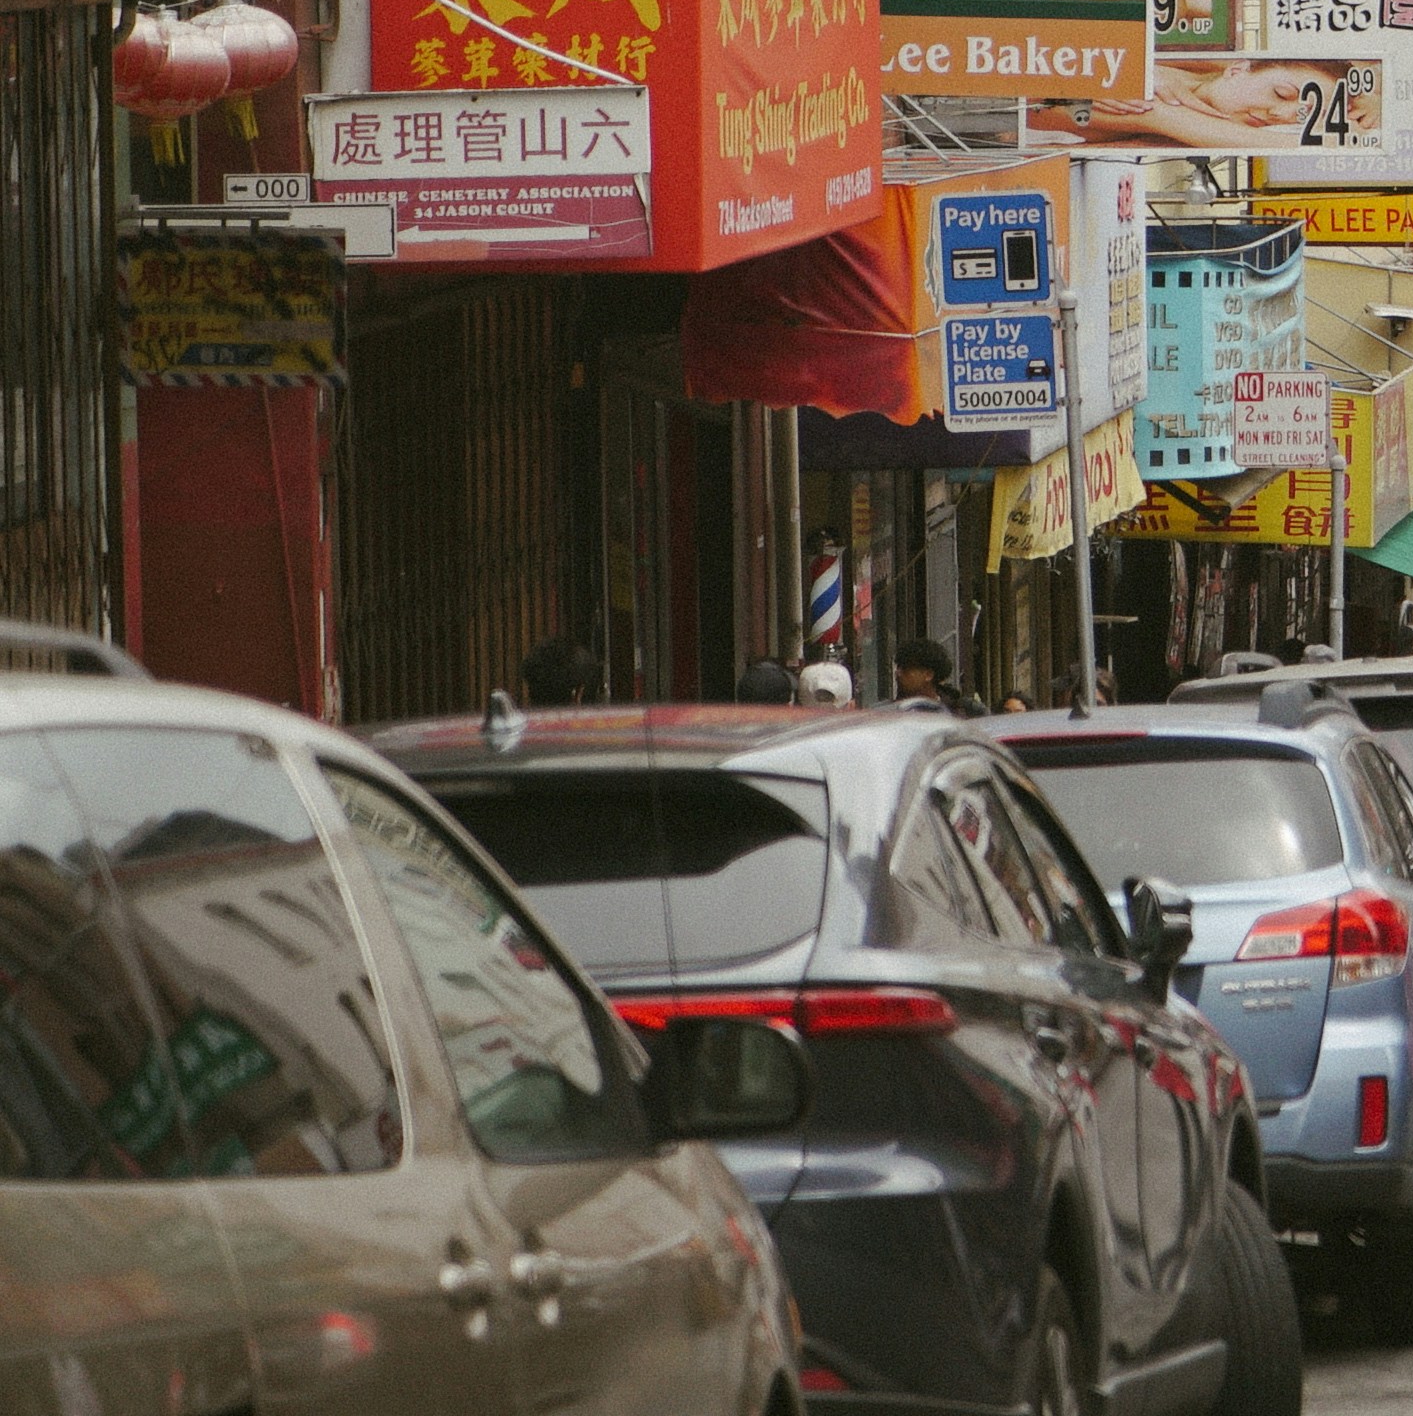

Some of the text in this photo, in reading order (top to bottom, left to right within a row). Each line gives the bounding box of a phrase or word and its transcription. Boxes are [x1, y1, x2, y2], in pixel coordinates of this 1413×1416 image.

[966, 36, 1126, 88] Bakery
[716, 66, 868, 175] Tung Shing Trading Co.
[1362, 138, 1377, 149] UP
[334, 185, 634, 204] CHINESE CEMETERY ASSOCIATION
[413, 202, 555, 219] 34 JASON COURT
[736, 197, 770, 233] Jackson
[771, 191, 794, 224] Street
[944, 203, 1041, 233] Pay here
[1331, 209, 1375, 232] LEE
[951, 319, 1022, 344] Pay by
[953, 342, 1029, 362] License
[1215, 348, 1243, 371] DVD
[953, 362, 1006, 383] Plate
[1237, 375, 1322, 398] NO PARKING
[959, 389, 1048, 409] 50007004
[1238, 430, 1323, 445] MON WED FRI SAT
[1242, 453, 1273, 463] STREET
